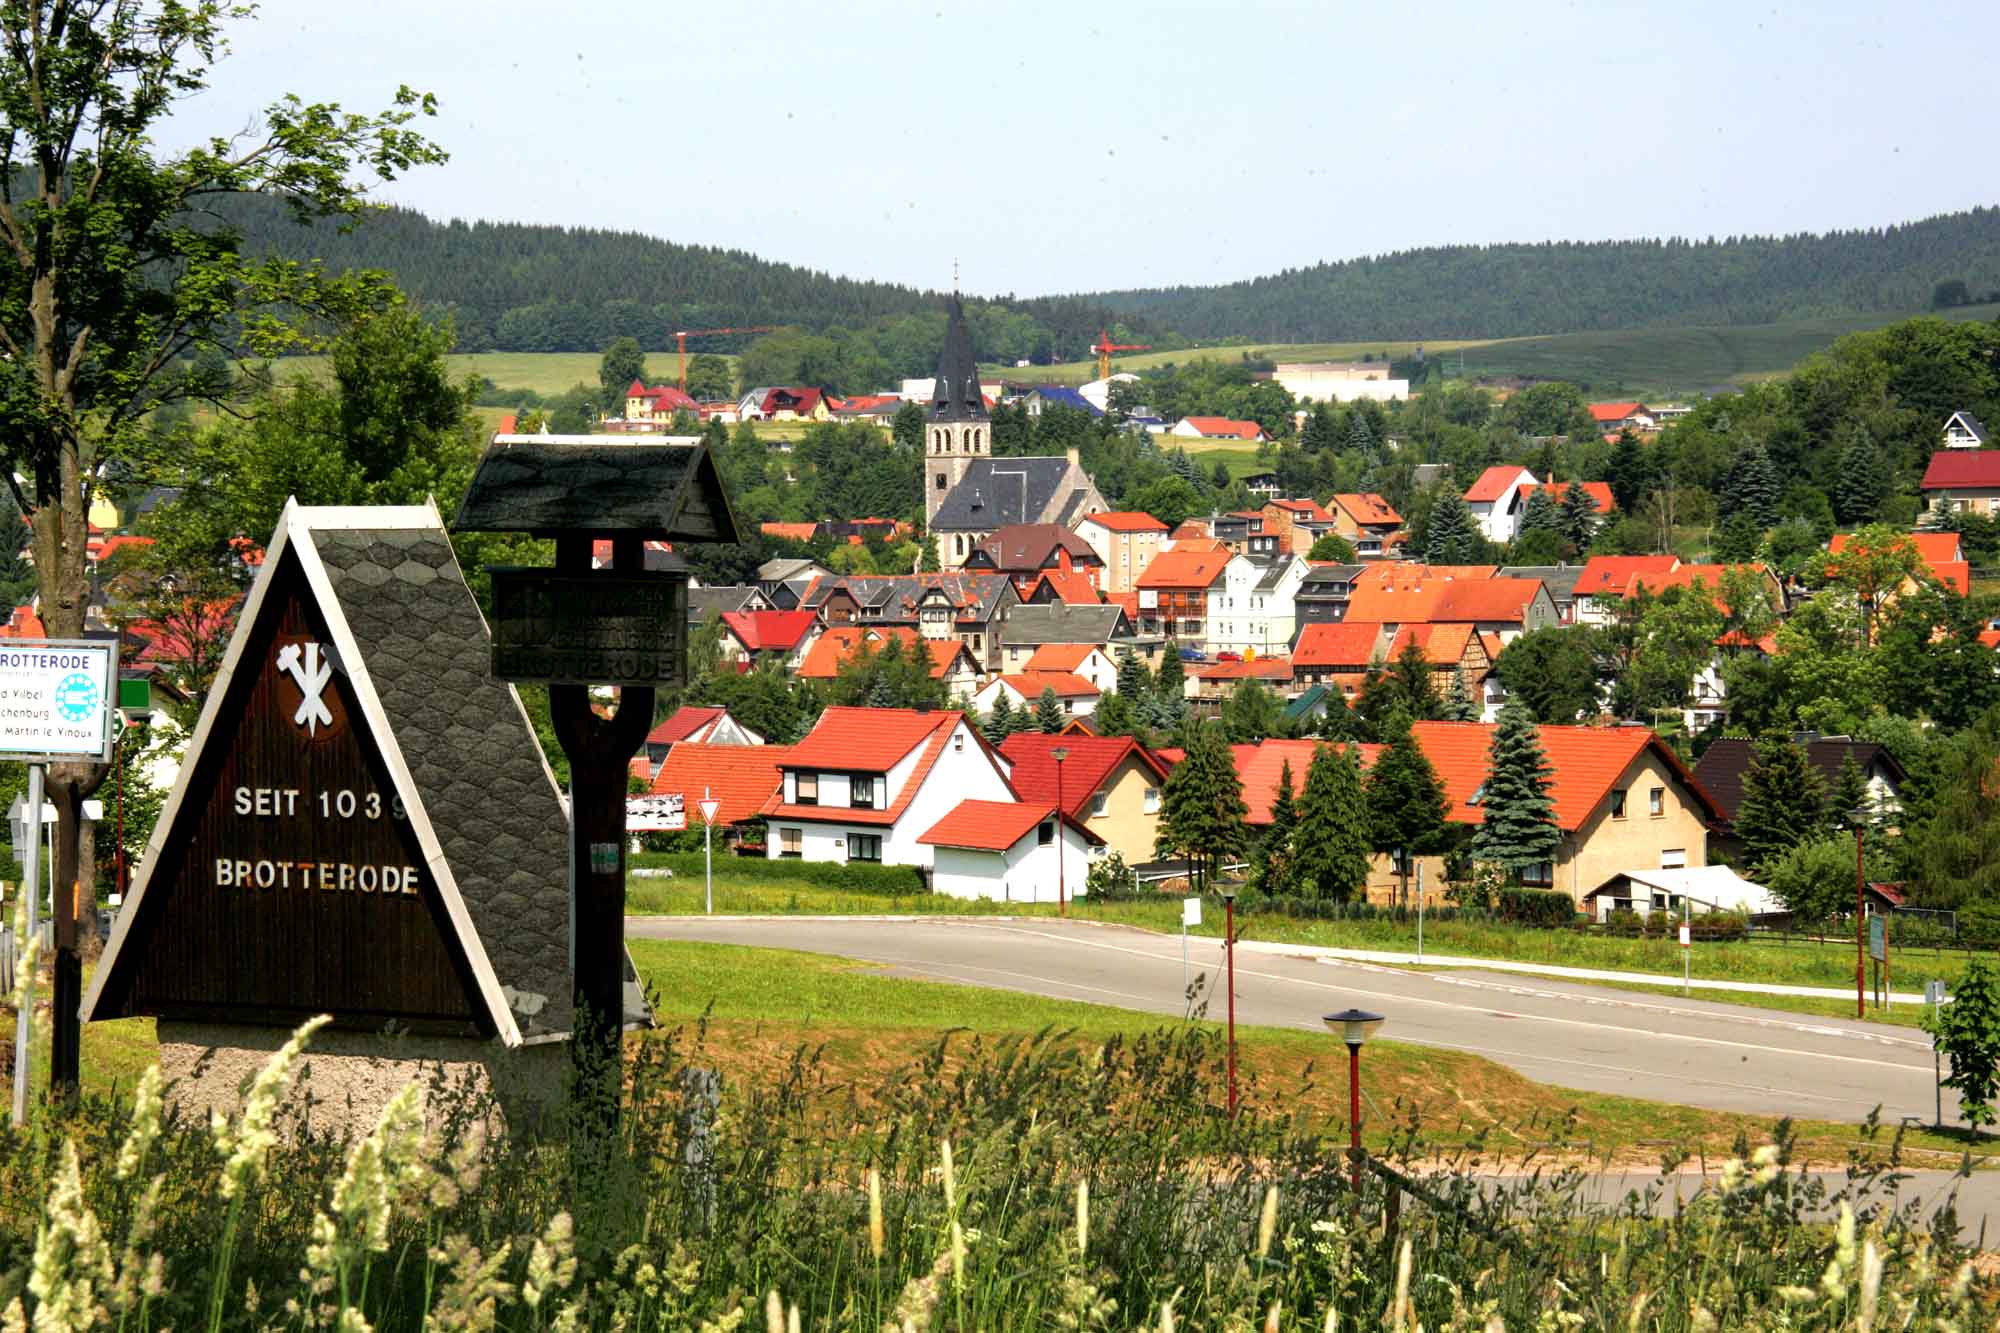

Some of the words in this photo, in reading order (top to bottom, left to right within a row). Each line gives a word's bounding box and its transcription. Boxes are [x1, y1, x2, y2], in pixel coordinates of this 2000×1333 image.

[0, 653, 90, 669] ROTTERODE
[12, 688, 43, 700] Vilbel
[0, 708, 50, 721] chenburg
[4, 726, 39, 737] Martin
[57, 727, 93, 738] Vinoux
[233, 786, 300, 816] SEIT
[215, 858, 420, 895] BROTTERODE
